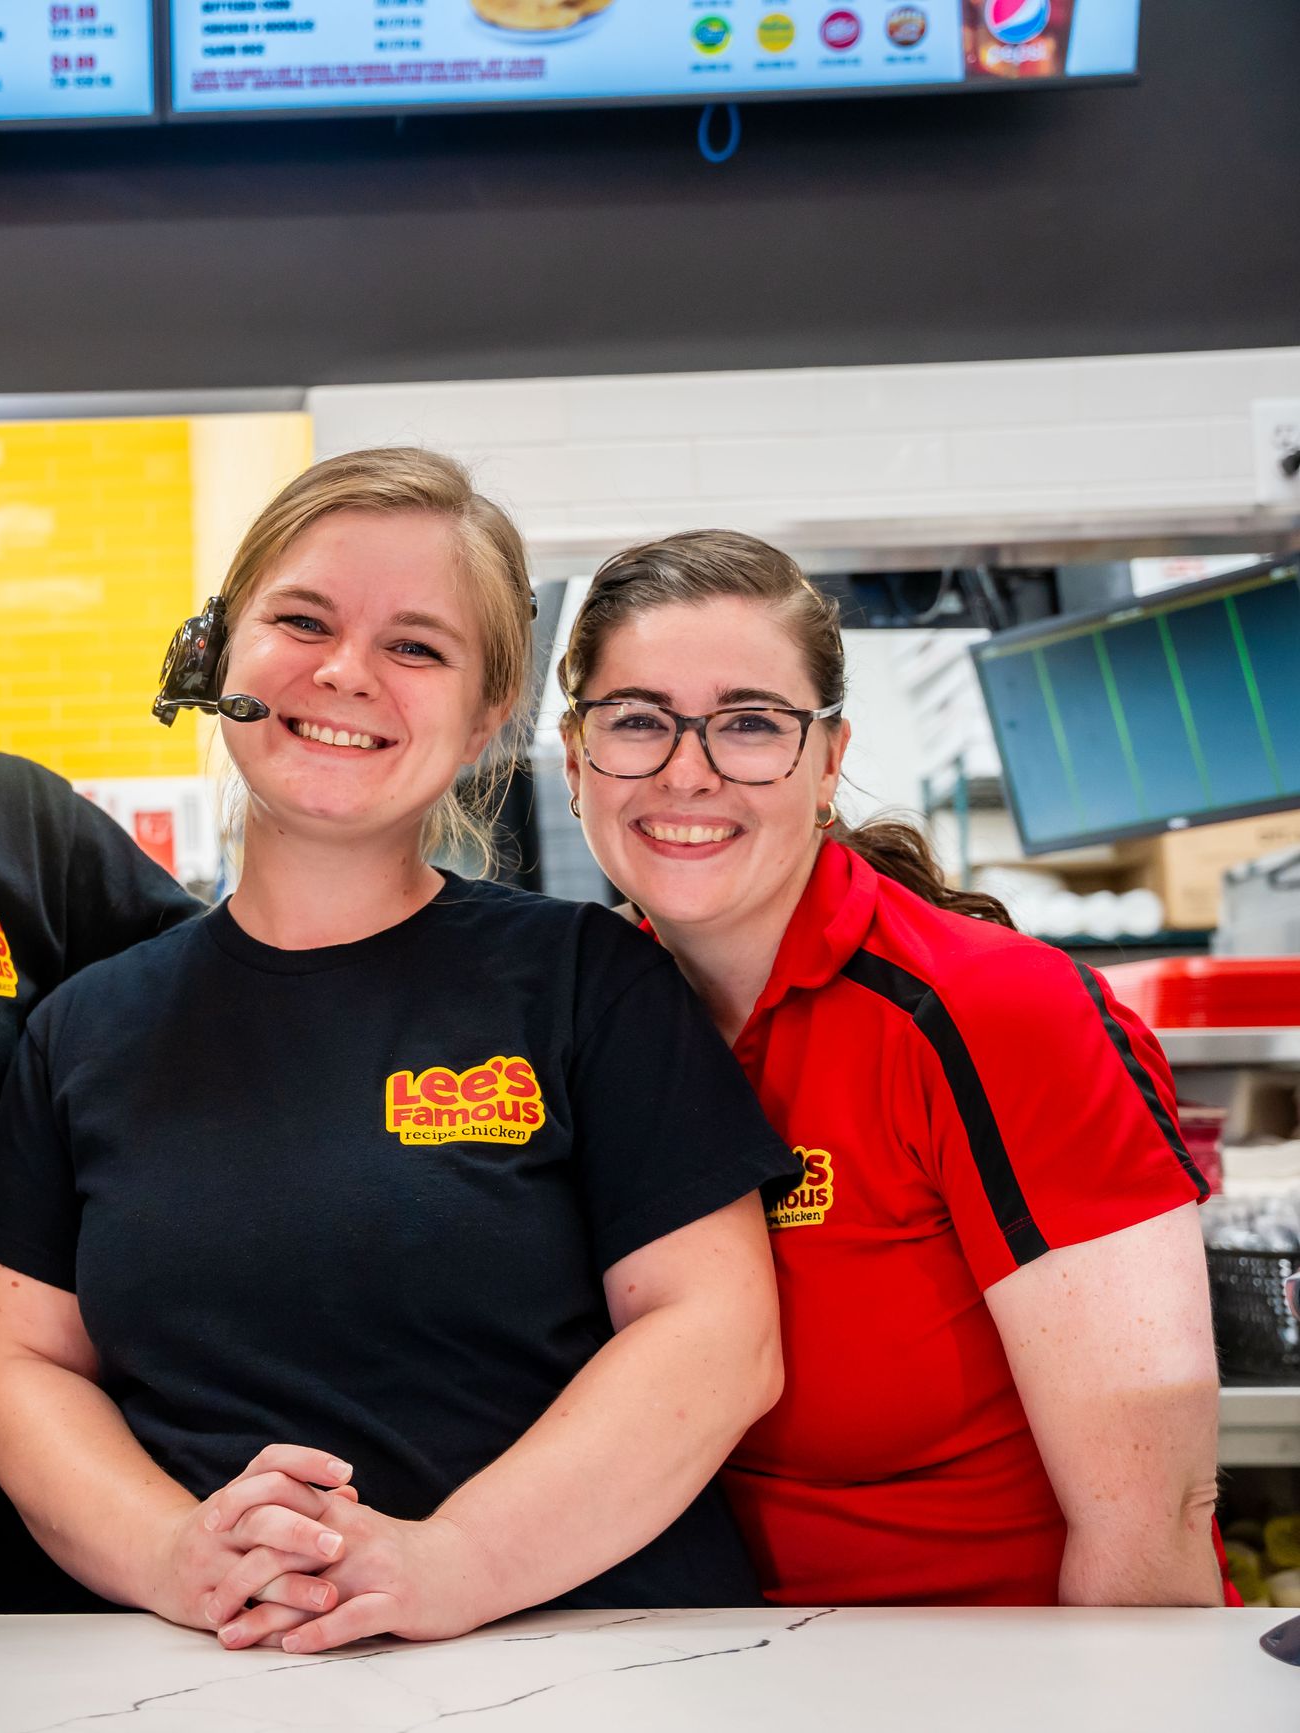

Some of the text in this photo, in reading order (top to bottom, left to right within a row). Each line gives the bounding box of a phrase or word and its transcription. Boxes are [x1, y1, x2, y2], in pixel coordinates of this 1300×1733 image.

[393, 1060, 537, 1106] Lee's
[393, 1100, 540, 1127] Famous
[405, 1125, 526, 1142] recipe chicken
[780, 1211, 821, 1224] chicken
